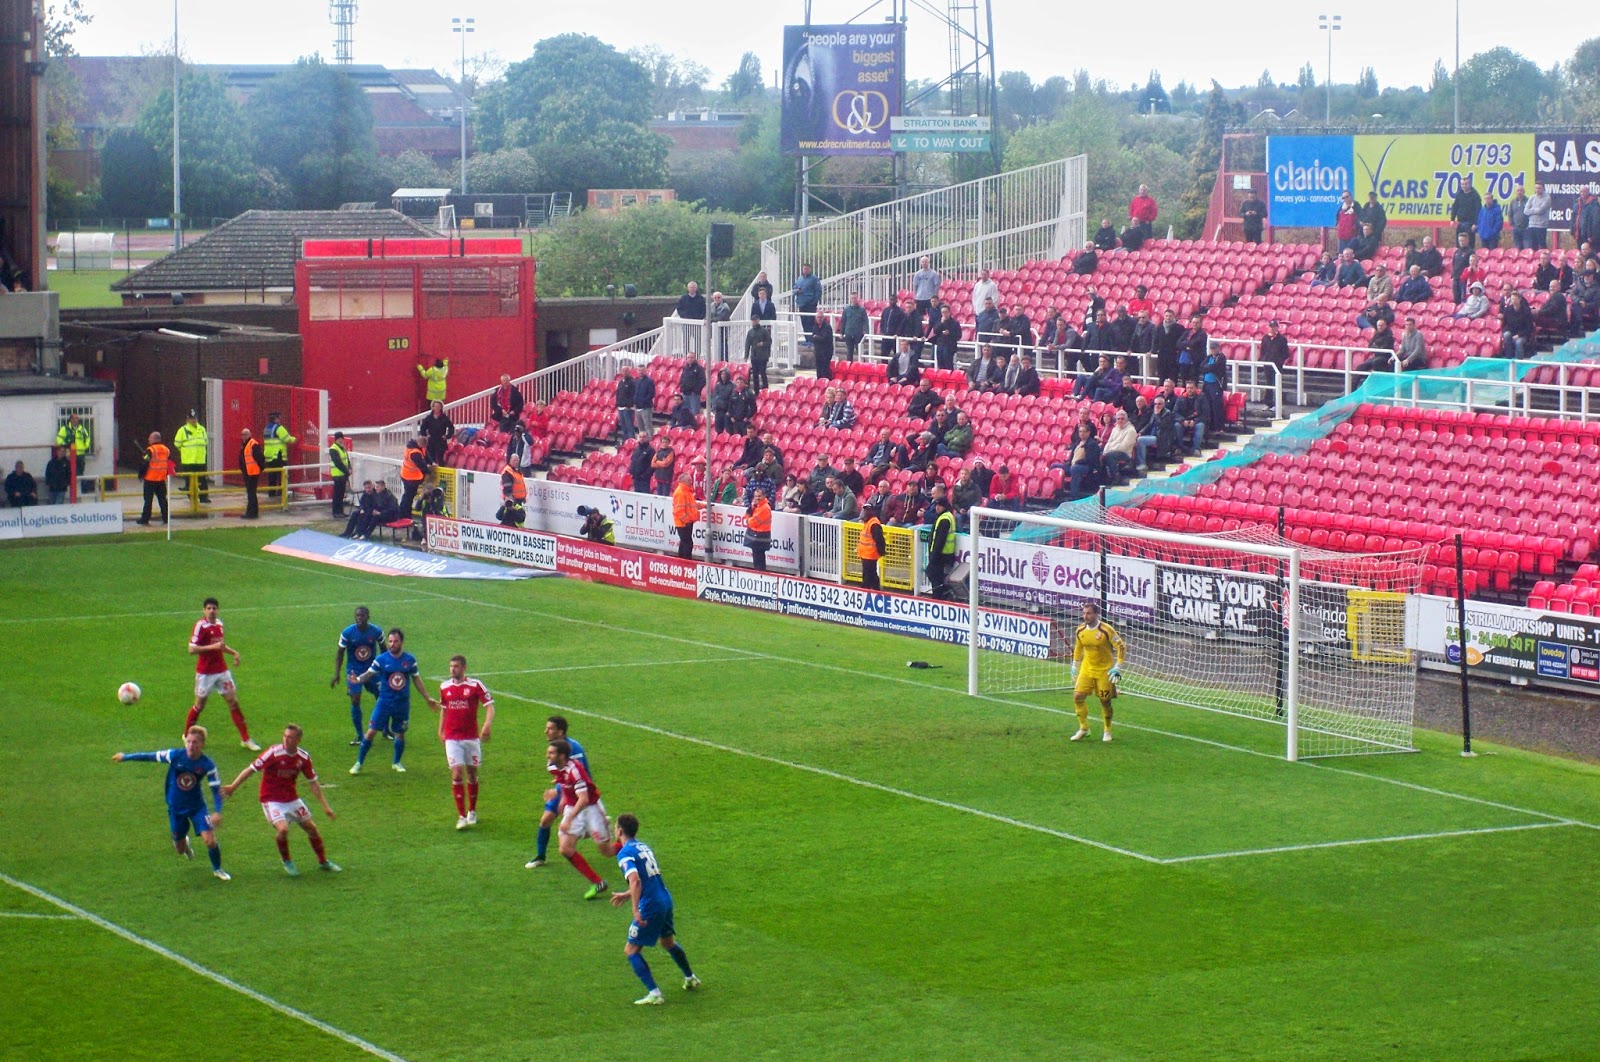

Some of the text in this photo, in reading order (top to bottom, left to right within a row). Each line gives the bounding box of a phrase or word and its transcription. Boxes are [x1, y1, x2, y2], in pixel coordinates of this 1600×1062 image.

[848, 33, 868, 45] are
[869, 33, 895, 48] your
[852, 50, 895, 66] biggest
[832, 90, 889, 135] C&D
[903, 119, 950, 128] STRATTON
[953, 118, 978, 128] BANK
[799, 139, 891, 150] www.cdrecruitment.co.uk
[913, 137, 984, 148] TO WAY OUT
[1451, 143, 1512, 167] 01793
[1379, 179, 1428, 199] CARS
[1274, 195, 1344, 205] moves you connects yo
[1398, 203, 1443, 216] PRIVATE
[388, 338, 409, 350] E10
[23, 515, 68, 528] Logistics
[70, 512, 118, 524] Solutions
[428, 520, 459, 538] FIRES
[727, 514, 748, 528] 720
[461, 525, 555, 551] ROYAL WOOTTON BASSETT
[625, 525, 665, 538] COTSWOLD
[355, 543, 448, 574] Nationwide
[462, 540, 555, 566] WWW.FIRES-FIREPLACES.CO.UK
[557, 542, 565, 551] for
[565, 543, 573, 553] the
[573, 545, 583, 555] best
[583, 547, 594, 558] jobs
[594, 550, 600, 559] in
[557, 555, 566, 564] call
[566, 557, 583, 569] another
[584, 561, 597, 572] great
[598, 563, 609, 574] team
[620, 556, 643, 581] red
[649, 561, 697, 580] 01793 490 794
[698, 565, 725, 586] J&M
[728, 570, 779, 599] Flooring
[820, 586, 840, 606] 542
[843, 590, 863, 610] 345
[1162, 571, 1266, 608] RAISE YOUR
[704, 590, 721, 603] Style,
[721, 592, 742, 604] Choice
[741, 596, 747, 605] &
[787, 603, 864, 627] jmflooring-swindon.co.uk
[863, 593, 1049, 640] ACE SCAFFOLDIN SWINDON
[1170, 597, 1222, 626] GAME
[1302, 603, 1347, 624] Swindo
[862, 616, 930, 637] Specialists in Contract Scaffolding
[1556, 623, 1586, 642] UNITS
[930, 626, 1049, 660] 01793 72530-07967 018329
[1445, 625, 1471, 644] 2,30
[1510, 636, 1523, 653] SQ
[1524, 637, 1536, 653] FT
[1485, 654, 1535, 670] AT KEMBREY PARK
[1541, 645, 1565, 660] loveday
[471, 755, 479, 766] 5
